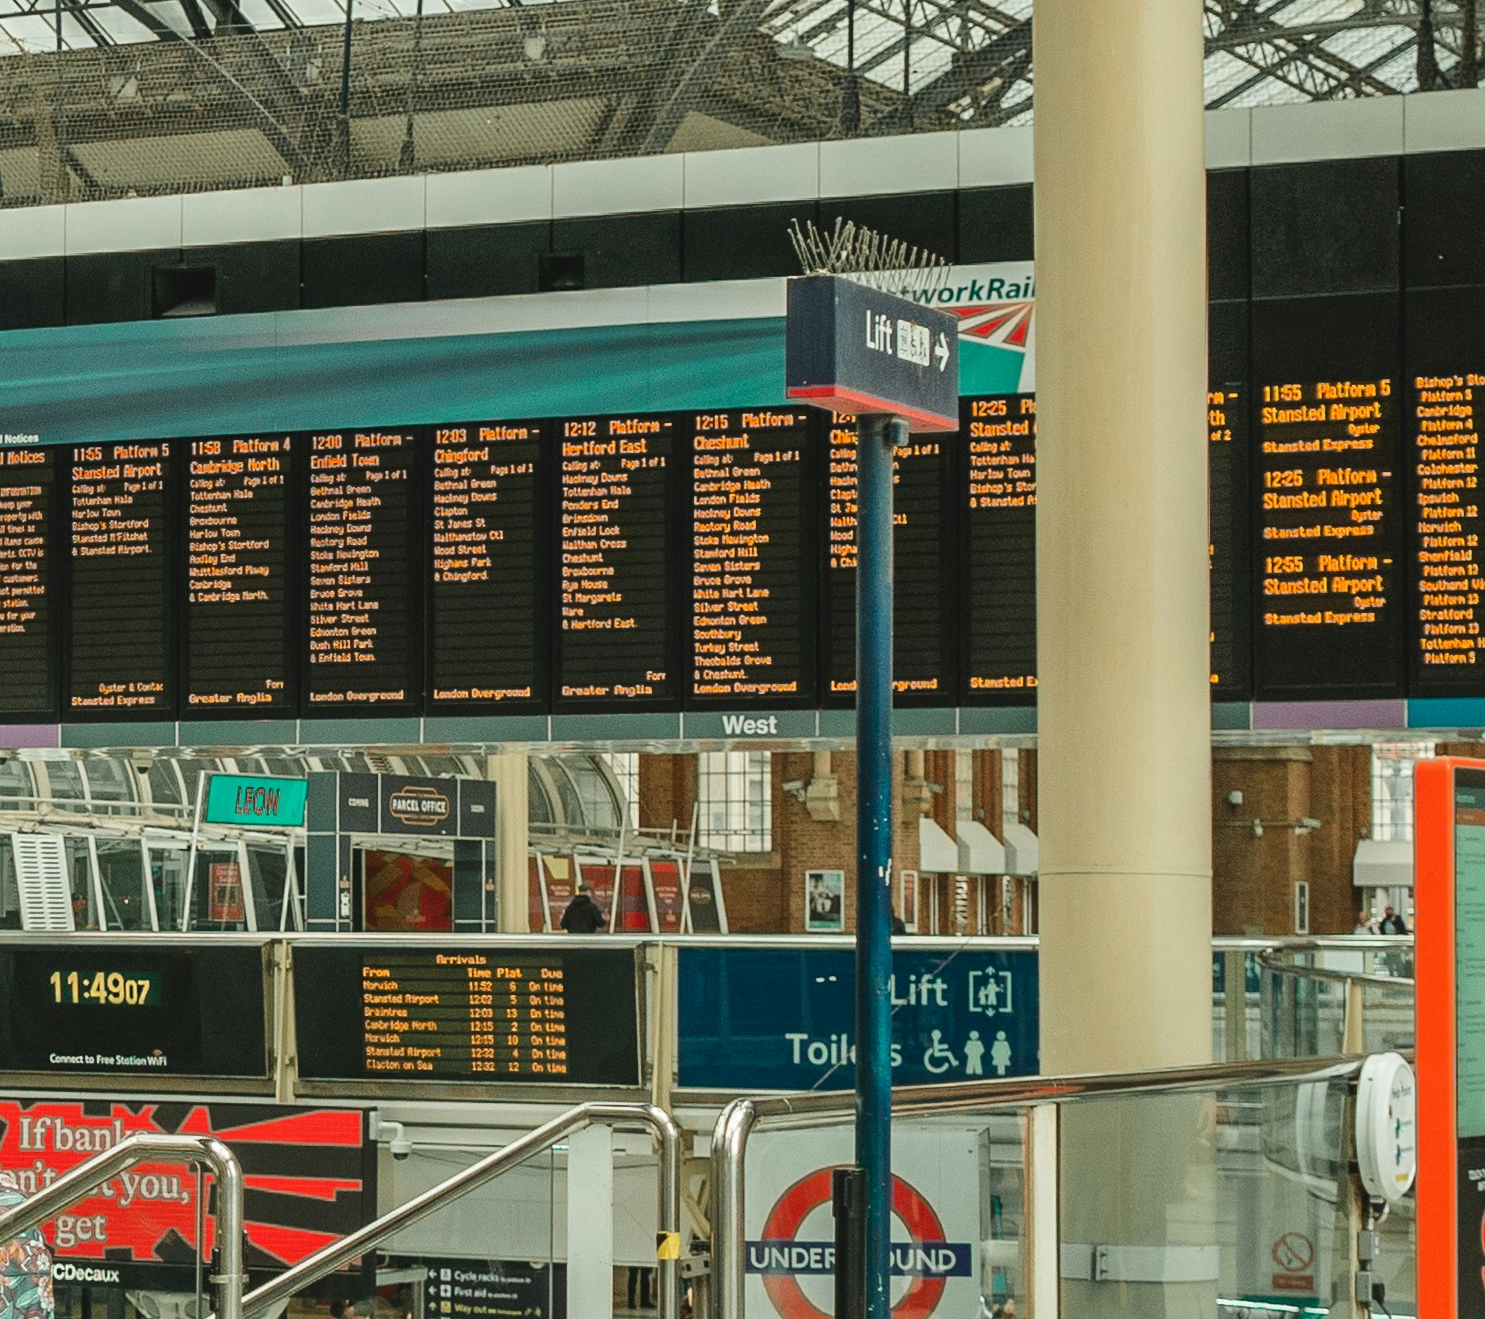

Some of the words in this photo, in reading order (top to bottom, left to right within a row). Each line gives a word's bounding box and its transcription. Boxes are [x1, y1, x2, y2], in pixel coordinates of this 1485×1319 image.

[865, 309, 893, 355] Lift
[1263, 384, 1302, 402] 11:55
[1316, 382, 1376, 401] Platform
[1380, 379, 1390, 396] 5
[742, 412, 793, 428] Platform
[1262, 405, 1325, 424] Stansted
[1330, 402, 1381, 421] Airport
[609, 419, 660, 435] Platform
[4, 433, 39, 445] Notices
[233, 439, 279, 454] Platform
[354, 433, 402, 448] Platform
[562, 440, 615, 457] Hertford
[619, 438, 647, 453] East
[694, 434, 749, 450] Cheshunt
[7, 450, 45, 465] Notices
[114, 444, 158, 461] Platform
[434, 447, 489, 464] Chingford
[72, 466, 119, 481] Stansted
[123, 464, 162, 479] Airport
[1317, 468, 1377, 486] Platform
[1262, 490, 1326, 509] Stansted
[1331, 488, 1382, 507] Airport
[1317, 554, 1377, 573] Platform
[1263, 577, 1327, 595] Stansted
[1332, 575, 1383, 594] Airport
[721, 714, 778, 735] West
[236, 786, 281, 816] LEON
[392, 798, 420, 812] PARCEL
[420, 799, 446, 814] OFFICE
[435, 954, 487, 965] Arrivals
[362, 967, 390, 978] From
[467, 967, 492, 979] Time
[496, 967, 523, 978] Plat
[541, 968, 564, 979] Due
[890, 974, 948, 1006] Lift
[785, 1032, 902, 1067] Toils
[49, 1053, 83, 1064] Connect
[84, 1054, 95, 1064] to
[96, 1054, 115, 1065] Free
[115, 1055, 147, 1066] Station
[147, 1056, 167, 1066] WiFi
[19, 1116, 51, 1151] If
[119, 1171, 191, 1208] you,
[55, 1214, 108, 1248] get
[750, 1247, 957, 1272] UNDERUND
[51, 1264, 120, 1283] CDecaux
[454, 1271, 477, 1282] Cycle
[478, 1274, 500, 1282] racks
[454, 1287, 473, 1297] First
[474, 1288, 487, 1298] aid
[454, 1303, 472, 1314] Way
[473, 1305, 487, 1314] out
